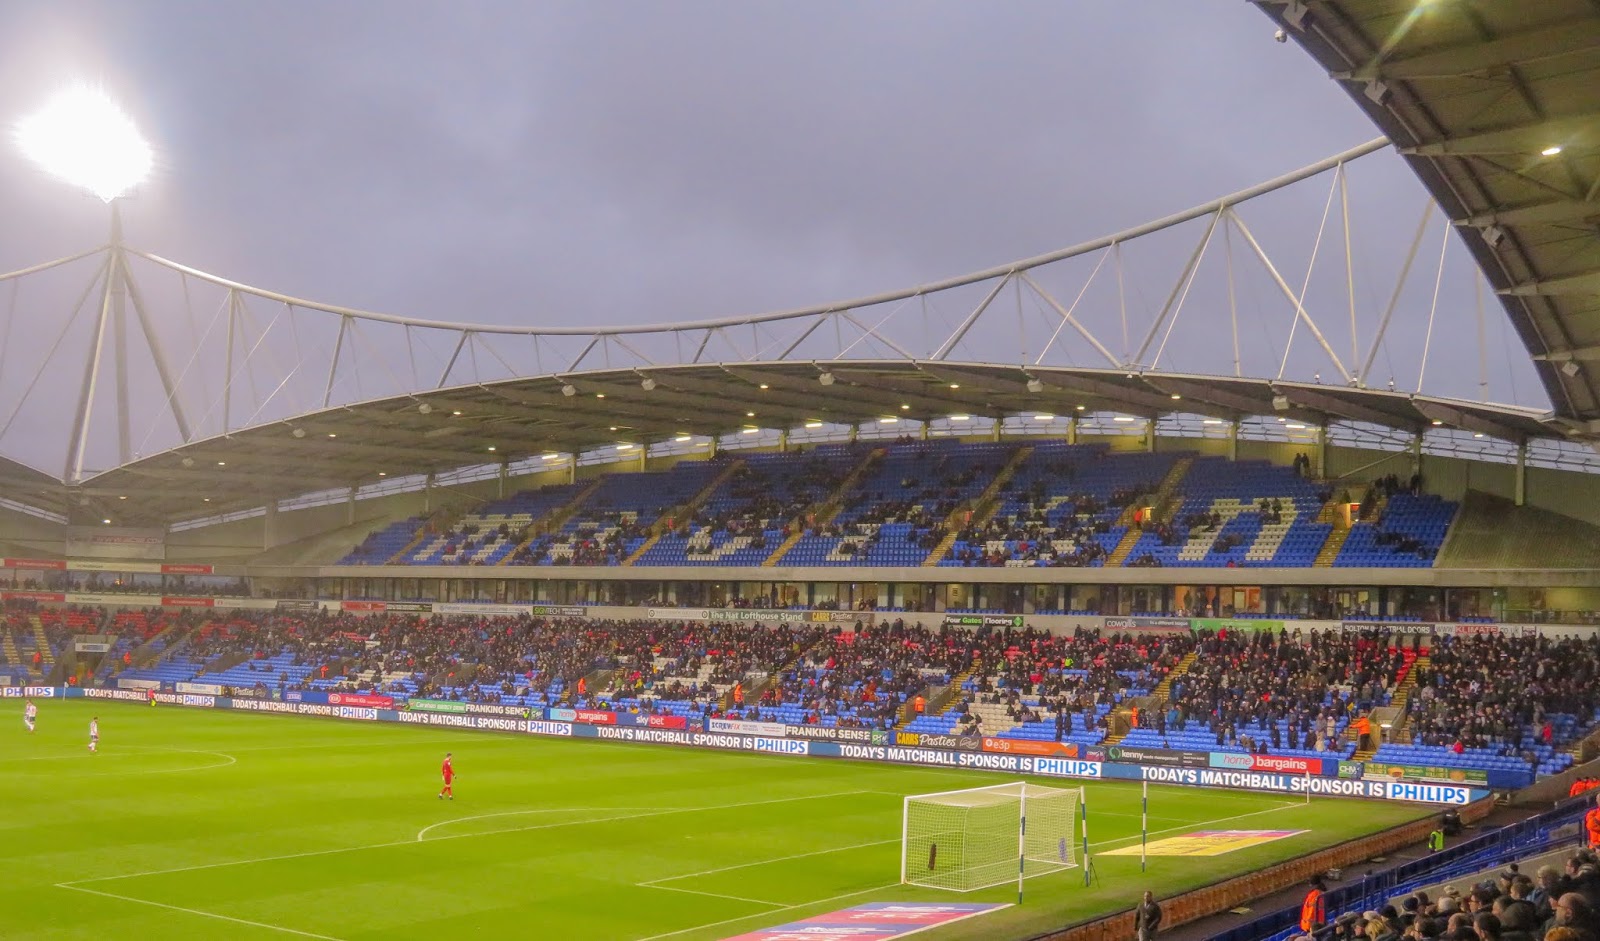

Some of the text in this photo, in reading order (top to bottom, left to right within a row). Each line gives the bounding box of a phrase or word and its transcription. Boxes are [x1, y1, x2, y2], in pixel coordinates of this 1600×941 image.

[725, 612, 739, 620] Nat
[740, 612, 778, 620] Lofthouse
[780, 612, 803, 621] Stand
[985, 617, 1012, 626] Flooring
[1408, 626, 1430, 634] DOORS
[1456, 626, 1498, 634] KLIMATE
[6, 688, 51, 696] PHLIPS
[83, 688, 112, 698] TODAY'S
[113, 690, 147, 700] MATCHBALL
[147, 692, 176, 703] PONSOR
[186, 696, 213, 706] PHILIPS
[232, 699, 375, 718] TODAY'S MATCHBALL SPONSOR IS PHILIPS
[466, 704, 503, 714] FRANKING
[398, 712, 569, 735] TODAY'S MATCHBALL SPONSOR IS PHILIPS
[636, 716, 664, 725] sky bet
[786, 726, 836, 738] FRANKING
[838, 730, 870, 740] SENSE
[597, 727, 805, 754] TODAY'S MATCHBALL SPONSOR IS PHILIPS
[920, 734, 956, 747] Pasties
[993, 740, 1010, 751] e3p
[840, 744, 1098, 776] TODAY'S MATCHBALL SPONSOR IS PHILIPS
[1122, 750, 1143, 760] kenny
[1224, 754, 1307, 770] home bargains
[1141, 767, 1465, 804] TODAY'S MATCHBALL SPONSOR IS PHILIPS
